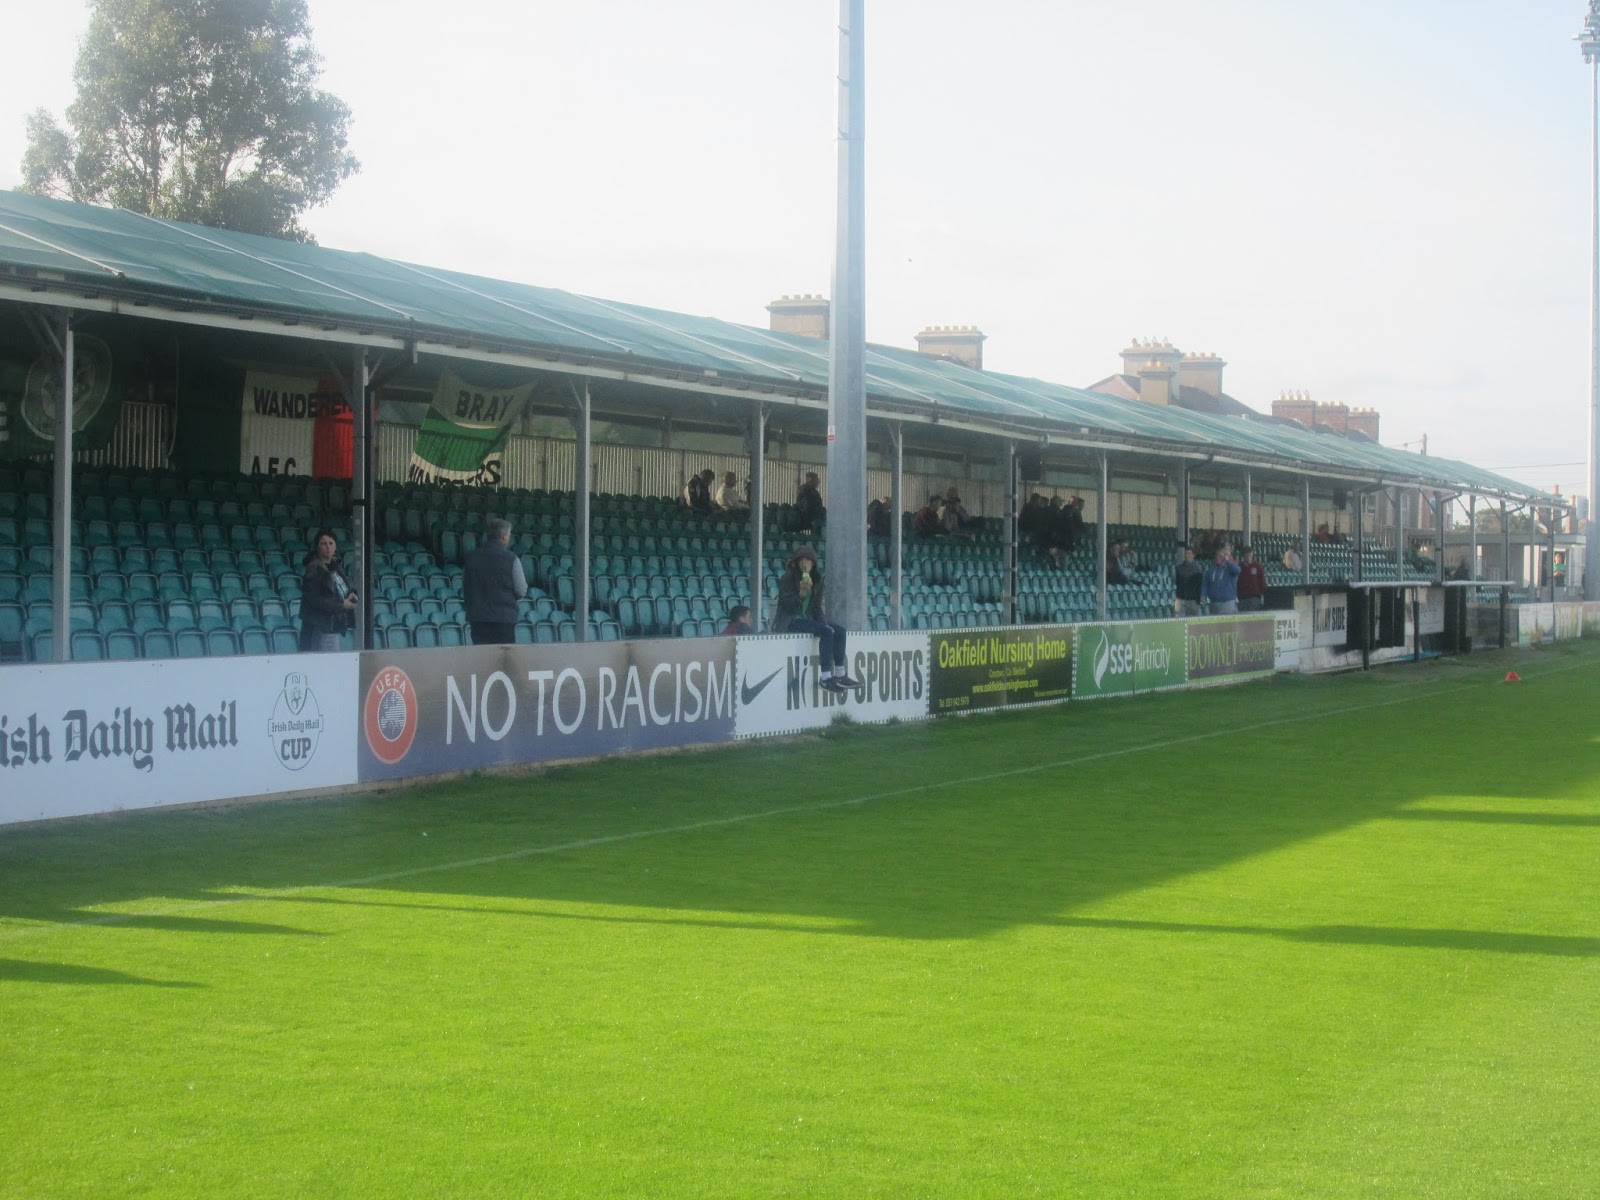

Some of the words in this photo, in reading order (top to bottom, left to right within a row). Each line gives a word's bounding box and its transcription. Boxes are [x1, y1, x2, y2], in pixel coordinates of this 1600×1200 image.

[455, 389, 515, 422] BRAY
[1332, 606, 1346, 631] SIDE
[939, 639, 987, 668] Oakfield
[990, 637, 1033, 668] Nursing
[1036, 635, 1066, 660] Home
[1110, 643, 1132, 674] sse
[1134, 641, 1171, 675] Airtricity
[1189, 631, 1239, 670] DOWNEY
[375, 673, 407, 694] UEFA
[854, 649, 923, 704] SPORTS
[446, 671, 517, 744] NO
[529, 667, 587, 736] TO
[597, 660, 733, 731] RACISM
[62, 706, 154, 773] Daily
[164, 700, 239, 752] Mail
[271, 721, 287, 733] Irish
[288, 720, 304, 733] Daily
[305, 718, 319, 730] Mail
[281, 737, 312, 761] CUP
